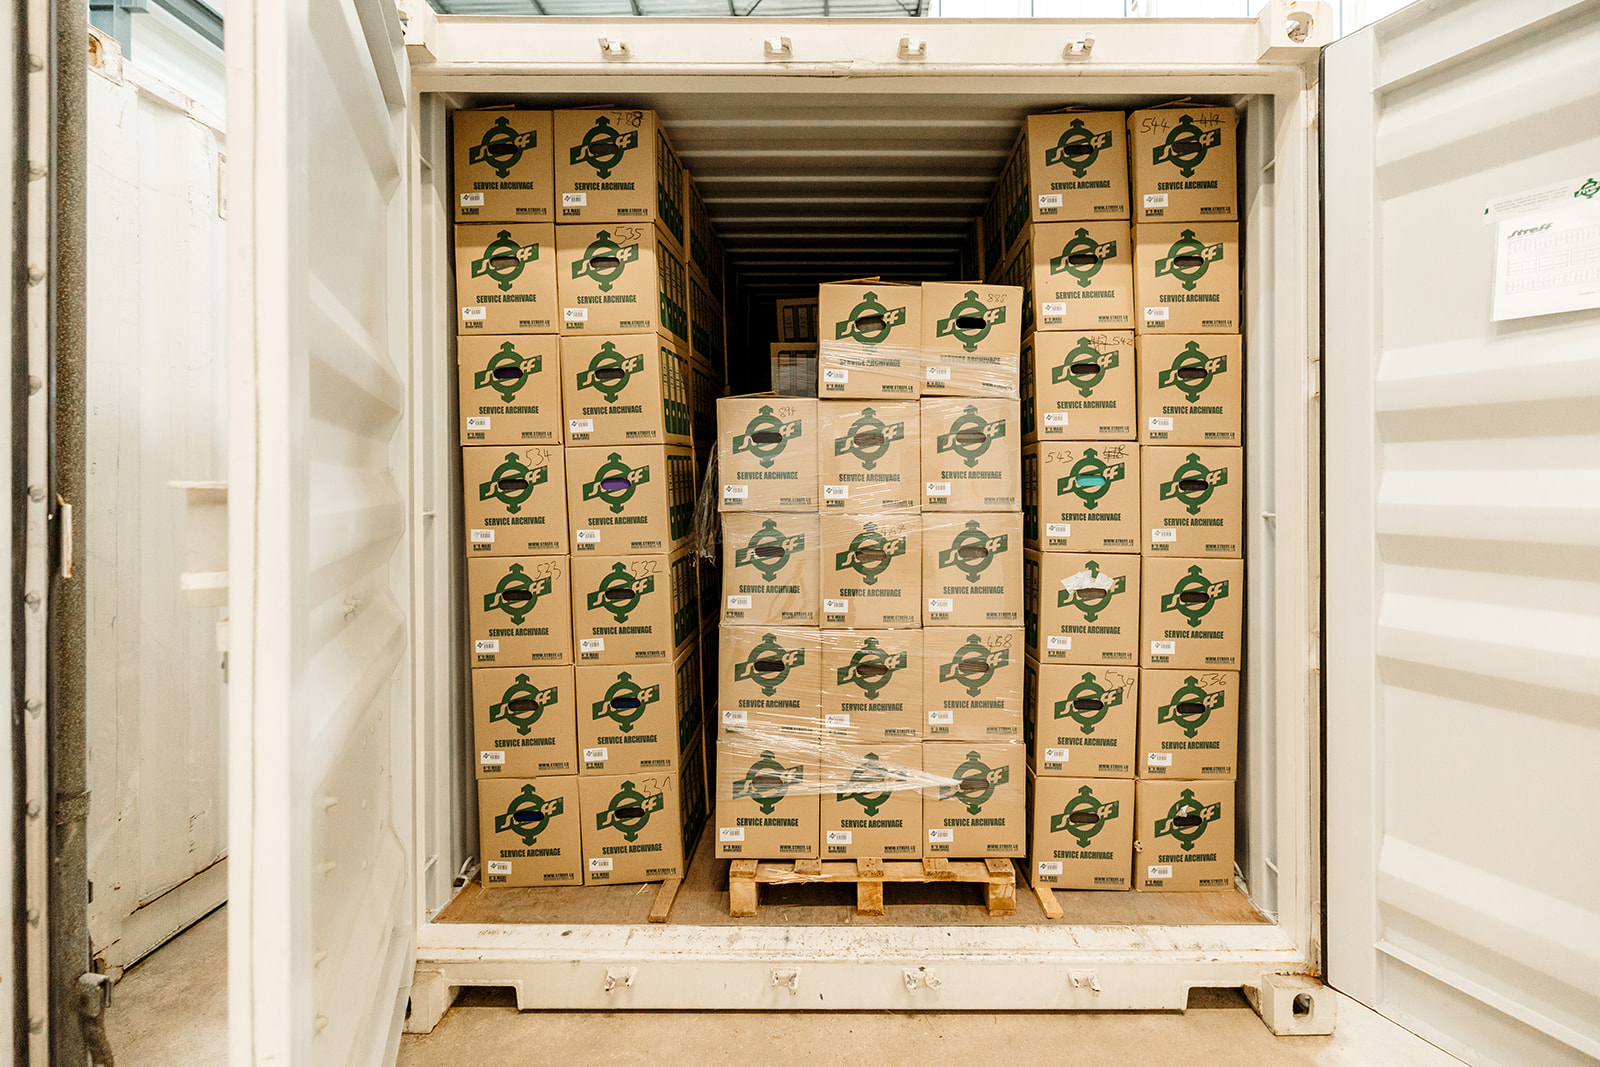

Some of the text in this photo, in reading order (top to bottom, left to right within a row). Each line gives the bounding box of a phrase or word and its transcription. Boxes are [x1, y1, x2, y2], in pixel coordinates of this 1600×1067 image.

[1140, 117, 1170, 133] 544
[474, 182, 533, 190] SERVICE ARCHIVAGE
[575, 182, 634, 190] SERVICE ARCHIVAGE
[1051, 180, 1110, 190] SERVICE ARCHIVAGE
[1158, 181, 1217, 190] SERVICE ARCHIVAGE
[476, 294, 536, 303] SERVICE ARCHIVAGE
[1056, 290, 1114, 299] SERVICE ARCHIVAGE
[1186, 294, 1219, 302] ARCHIVAGE
[577, 295, 636, 304] SERVICE ARCHIVAGE
[866, 358, 900, 367] ARCHIVAGE
[1057, 401, 1082, 409] SERVICE
[479, 406, 539, 414] SERVICE ARCHIVAGE
[583, 405, 642, 415] SERVICE ARCHIVAGE
[1163, 406, 1223, 414] SERVICE ARCHIVAGE
[525, 448, 552, 467] 534
[1045, 451, 1073, 463] 543
[737, 472, 762, 480] SERVICE
[839, 474, 900, 482] SERVICE ARCHIVAGE
[941, 471, 1002, 479] SERVICE ARCHIVAGE
[485, 516, 545, 526] SERVICE ARCHIVAGE
[588, 516, 648, 525] SERVICE ARCHIVAGE
[1061, 513, 1121, 521] SERVICE ARCHIVAGE
[1164, 518, 1223, 526] SERVICE ARCHIVAGE
[739, 585, 800, 593] SERVICE ARCHIVAGE
[840, 589, 901, 597] SERVICE ARCHIVAGE
[943, 586, 1004, 594] SERVICE ARCHIVAGE
[489, 628, 549, 637] SERVICE ARCHIVAGE
[592, 626, 652, 635] SERVICE ARCHIVAGE
[1061, 625, 1120, 634] SERVICE ARCHIVAGE
[1165, 630, 1224, 638] SERVICE ARCHIVAGE
[1200, 674, 1227, 688] 536
[739, 700, 800, 708] SERVICE ARCHIVAGE
[842, 703, 903, 711] SERVICE ARCHIVAGE
[944, 700, 969, 708] SERVICE
[495, 738, 555, 747] SERVICE ARCHIVAGE
[597, 735, 657, 744] SERVICE ARCHIVAGE
[1058, 737, 1117, 746] SERVICE ARCHIVAGE
[1188, 741, 1220, 749] ARCHIVAGE
[737, 818, 798, 826] SERVICE ARCHIVAGE
[841, 820, 902, 828] SERVICE ARCHIVAGE
[944, 818, 1005, 826] SERVICE ARCHIVAGE
[500, 848, 560, 858] SERVICE ARCHIVAGE
[602, 844, 662, 854] SERVICE ARCHIVAGE
[1054, 850, 1113, 860] SERVICE ARCHIVAGE
[1158, 853, 1216, 863] SERVICE ARCHIVAGE
